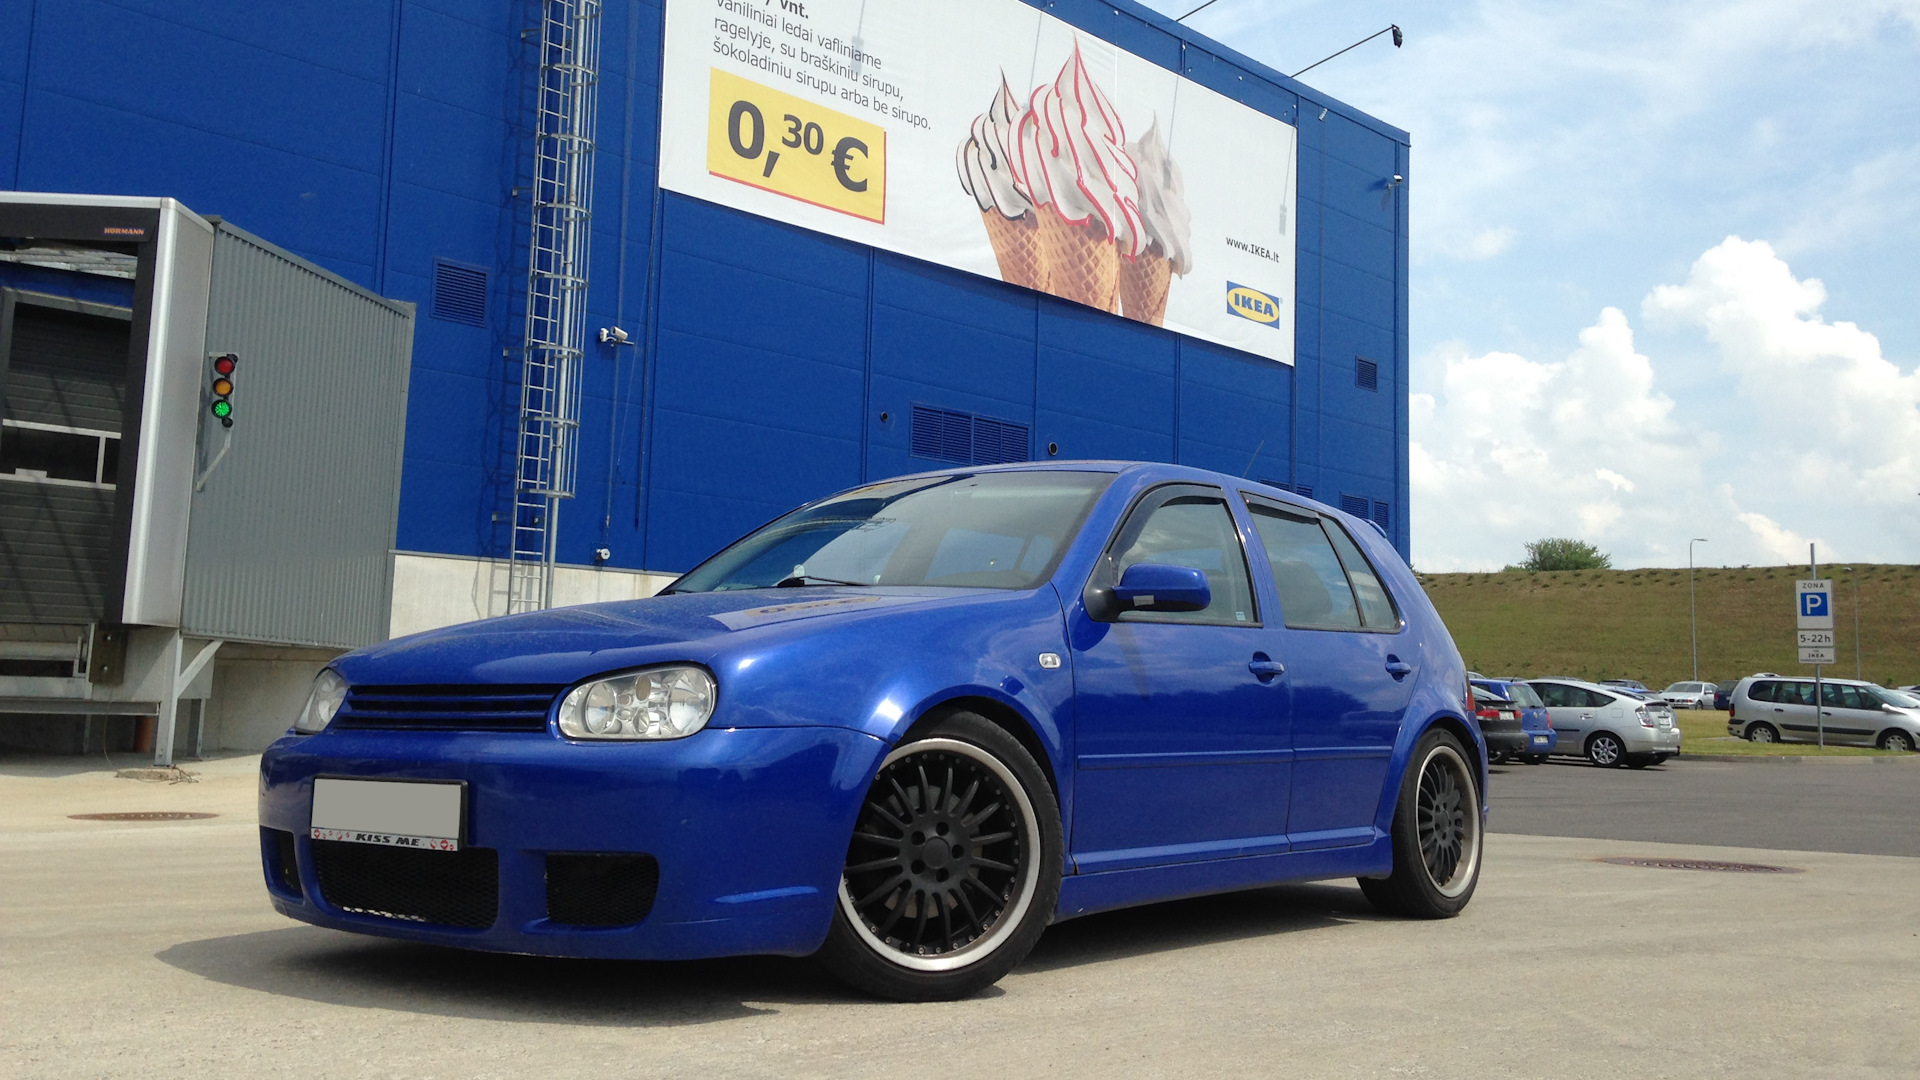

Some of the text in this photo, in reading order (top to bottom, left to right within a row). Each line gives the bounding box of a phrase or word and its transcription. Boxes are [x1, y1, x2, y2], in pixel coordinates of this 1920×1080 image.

[780, 0, 808, 19] vnt.
[782, 17, 813, 42] ledai
[817, 35, 882, 69] vafliniame
[714, 17, 904, 102] ragelyje, su braškiniu sirupu,
[713, 35, 931, 130] šokoladiniu sirupu arba be sirupo.
[1226, 237, 1279, 263] www.IKEA.lt
[1234, 293, 1274, 317] IKEA
[1806, 594, 1822, 615] P
[356, 833, 420, 846] KISS ME
